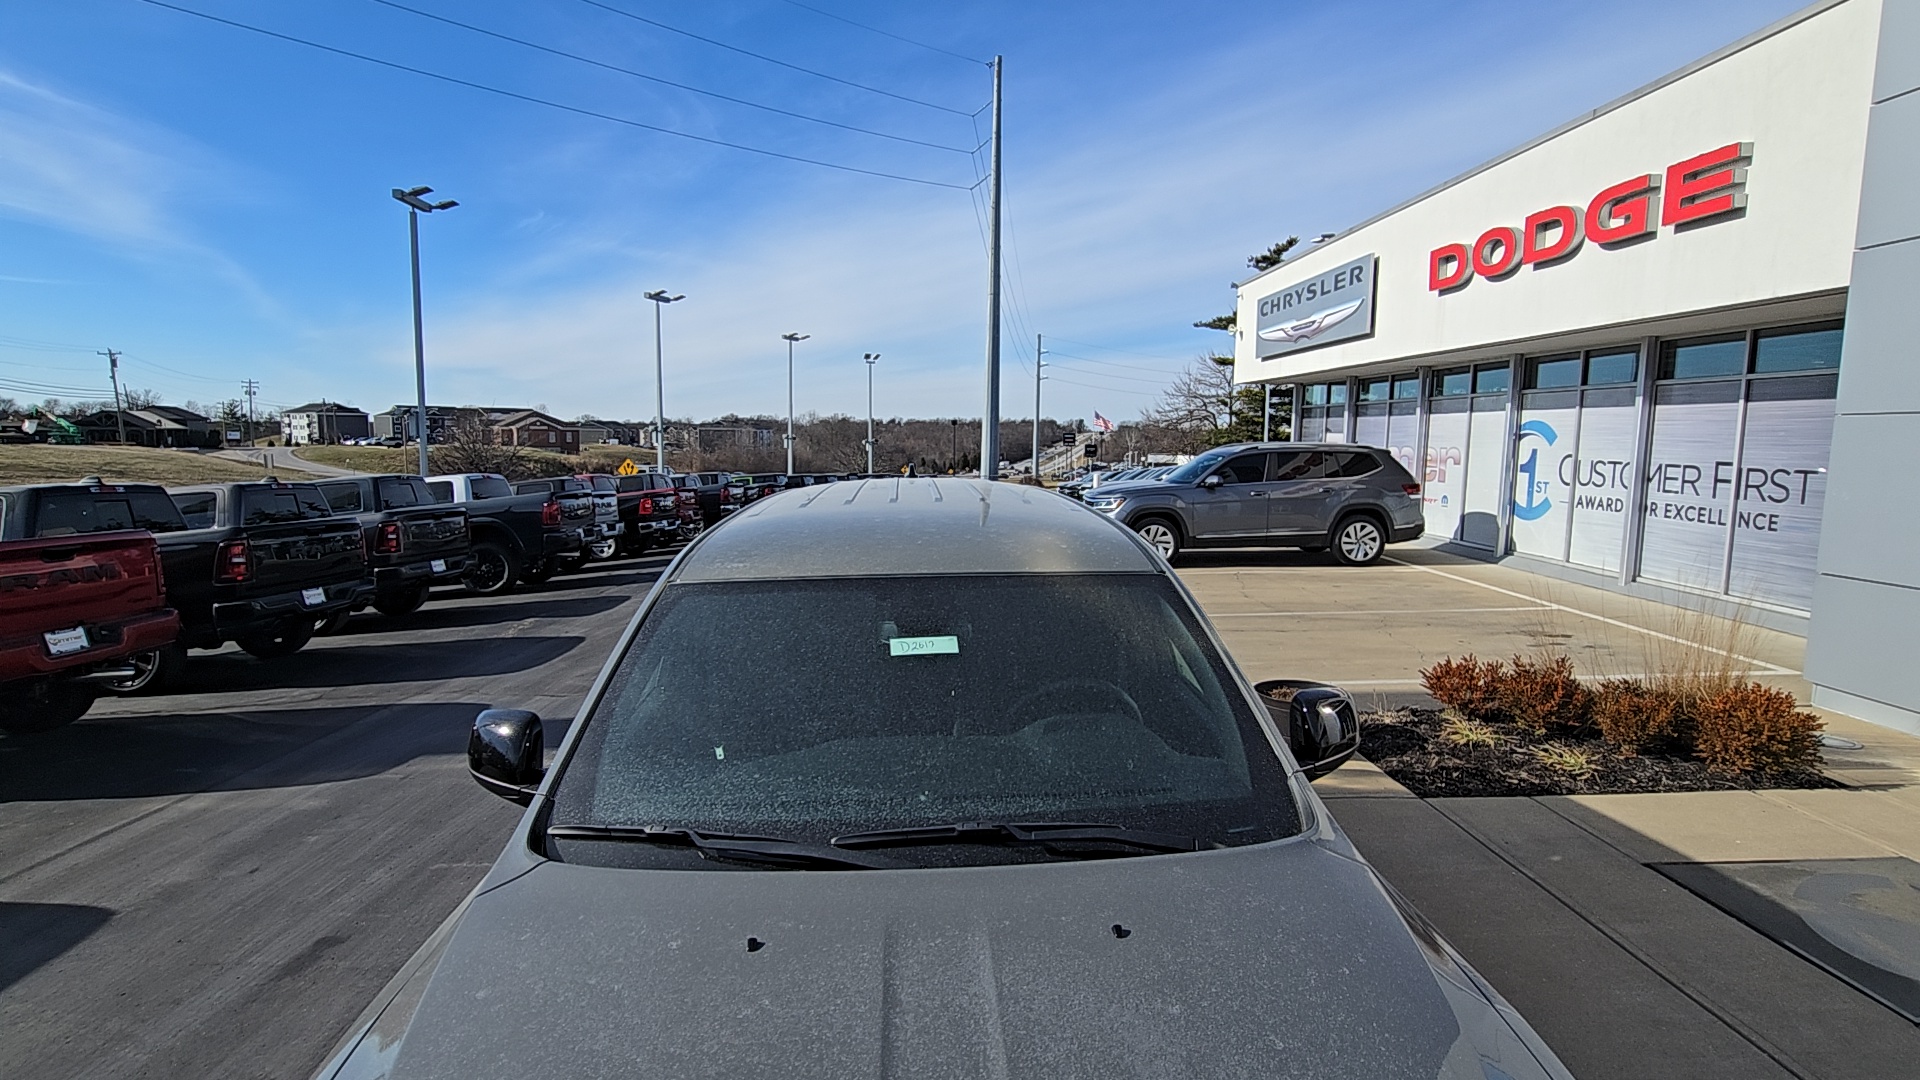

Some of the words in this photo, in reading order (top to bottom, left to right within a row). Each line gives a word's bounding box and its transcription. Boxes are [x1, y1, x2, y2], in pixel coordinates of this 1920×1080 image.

[1428, 142, 1753, 292] DODGE
[1260, 265, 1364, 317] CHRYSLER
[1712, 461, 1819, 505] FIRST
[1575, 495, 1624, 513] AWARD
[1663, 503, 1779, 532] EXCELLNCE
[290, 542, 343, 558] RAM
[1, 562, 120, 592] RAM
